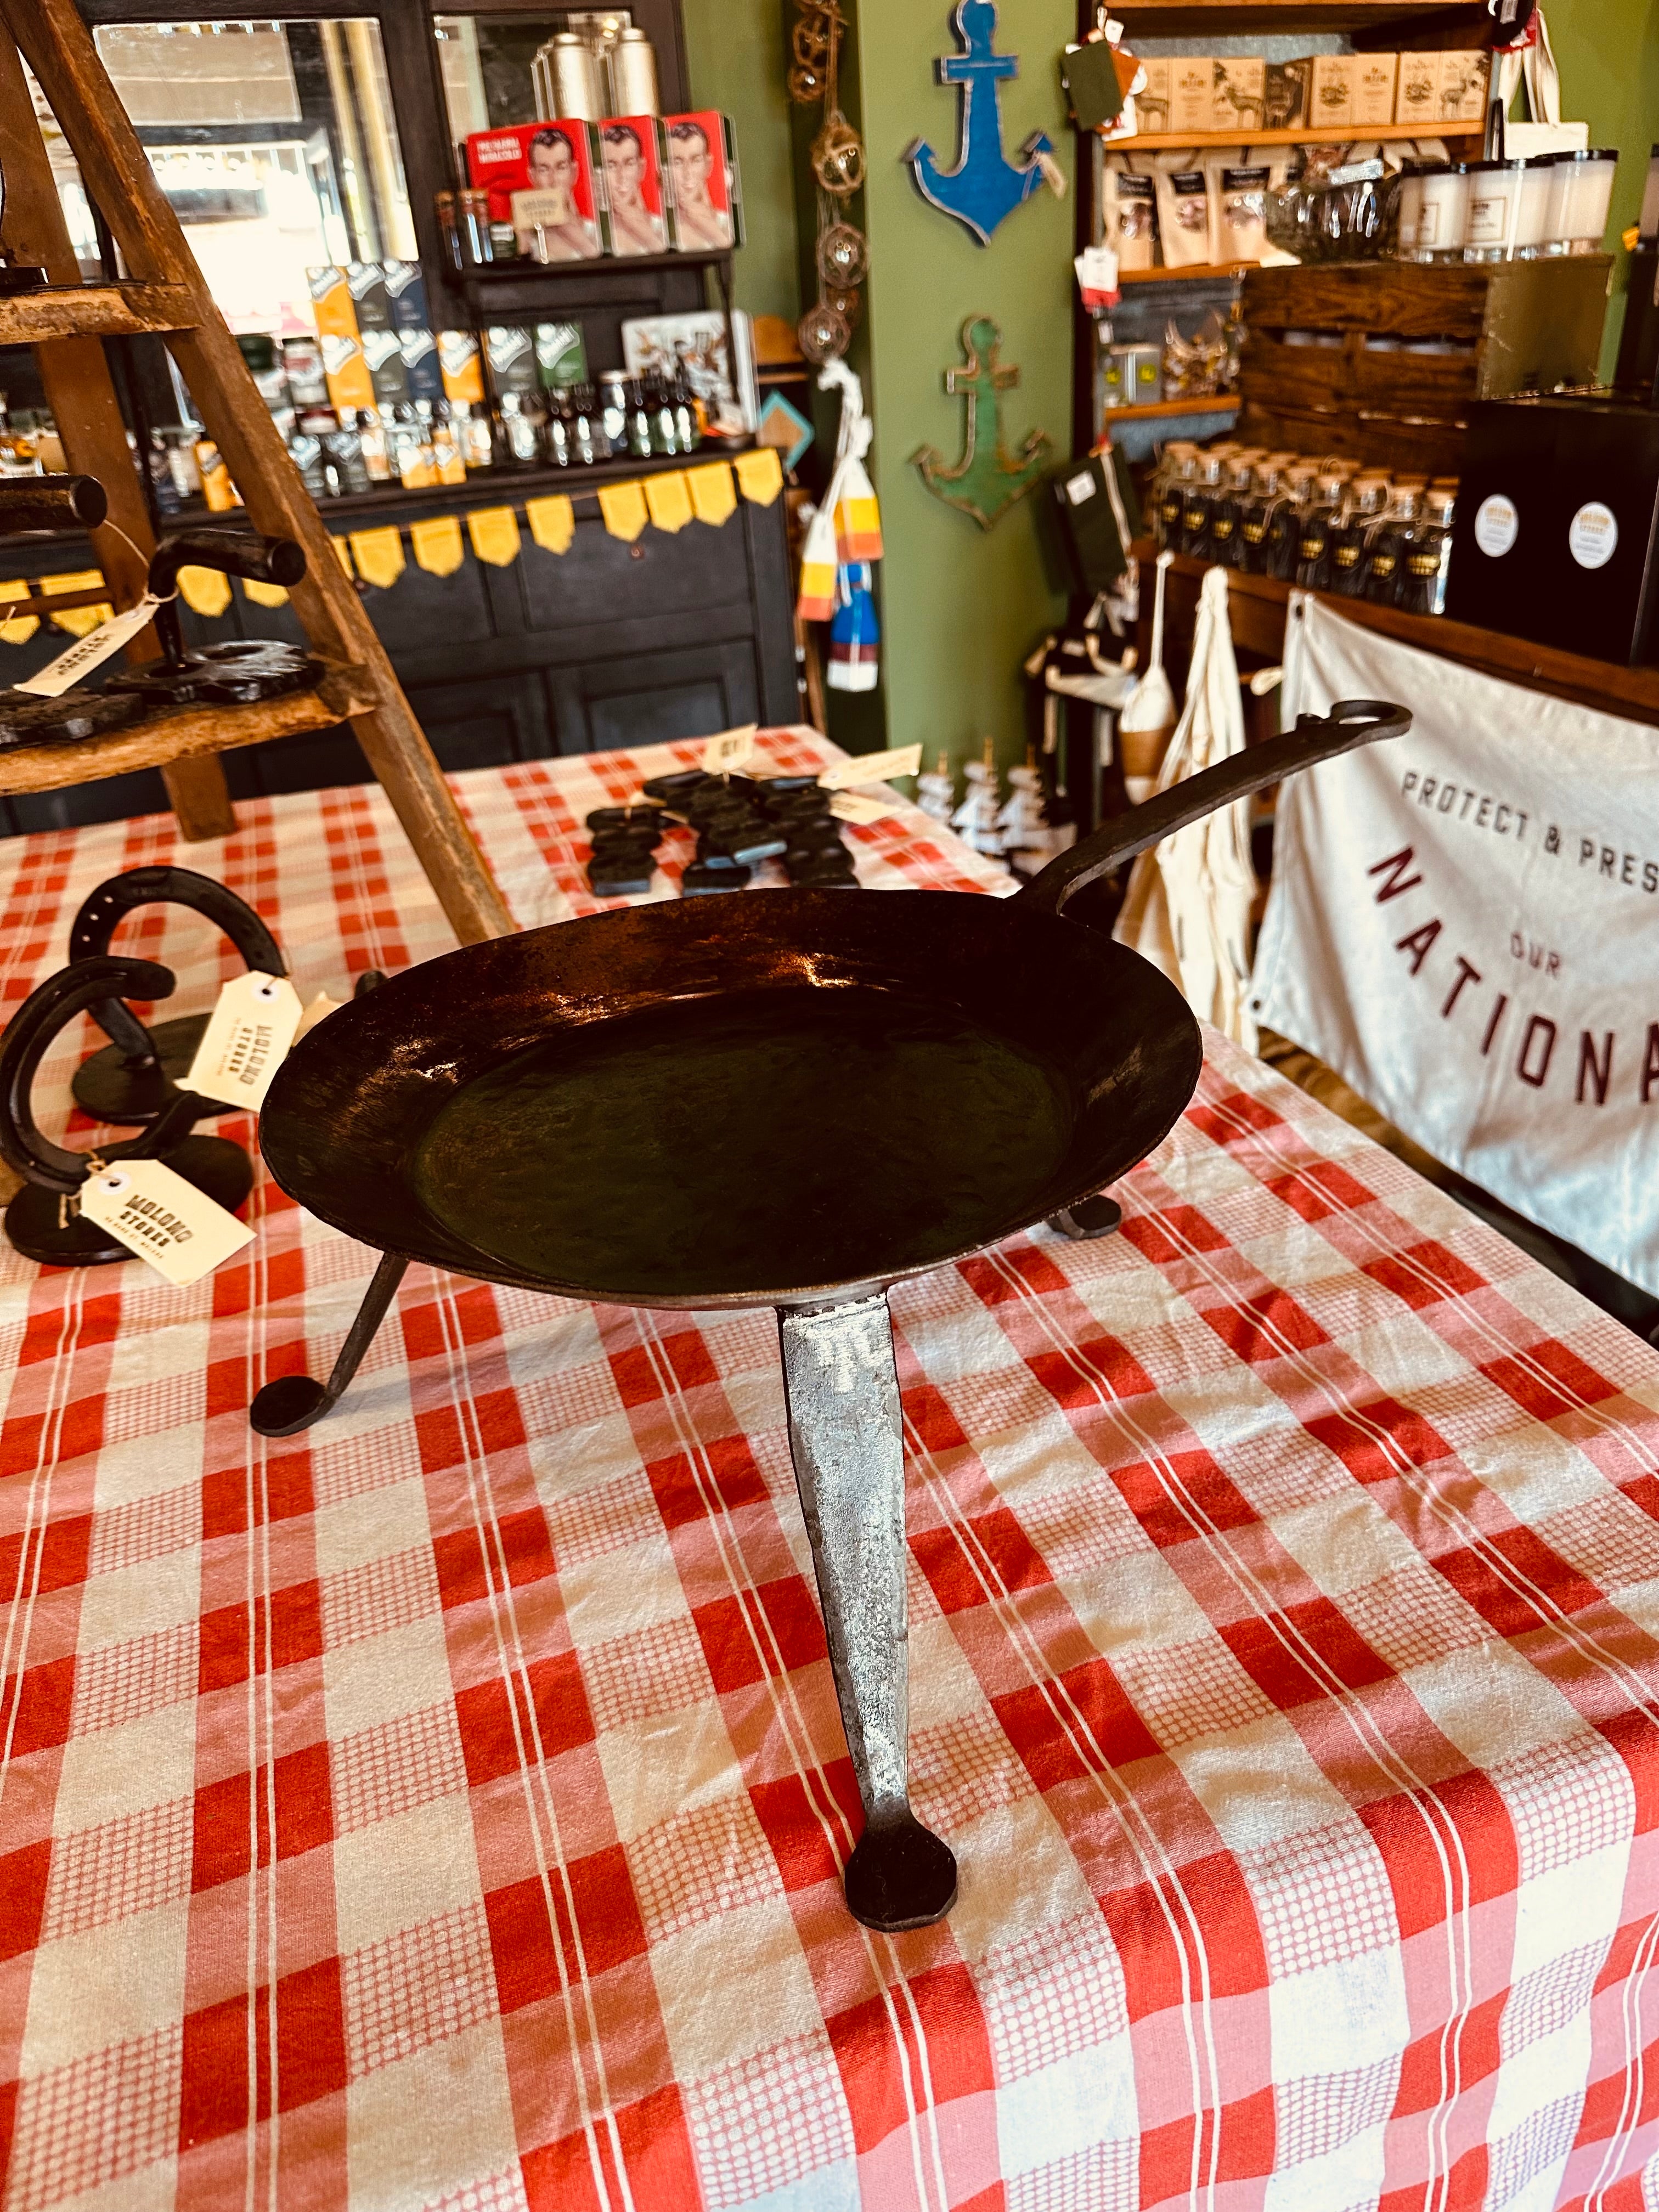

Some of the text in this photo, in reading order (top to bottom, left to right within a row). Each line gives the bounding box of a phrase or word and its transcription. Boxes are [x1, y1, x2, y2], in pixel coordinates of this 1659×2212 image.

[1402, 771, 1659, 894] PROTECT & PRES
[1510, 932, 1560, 980] OUR
